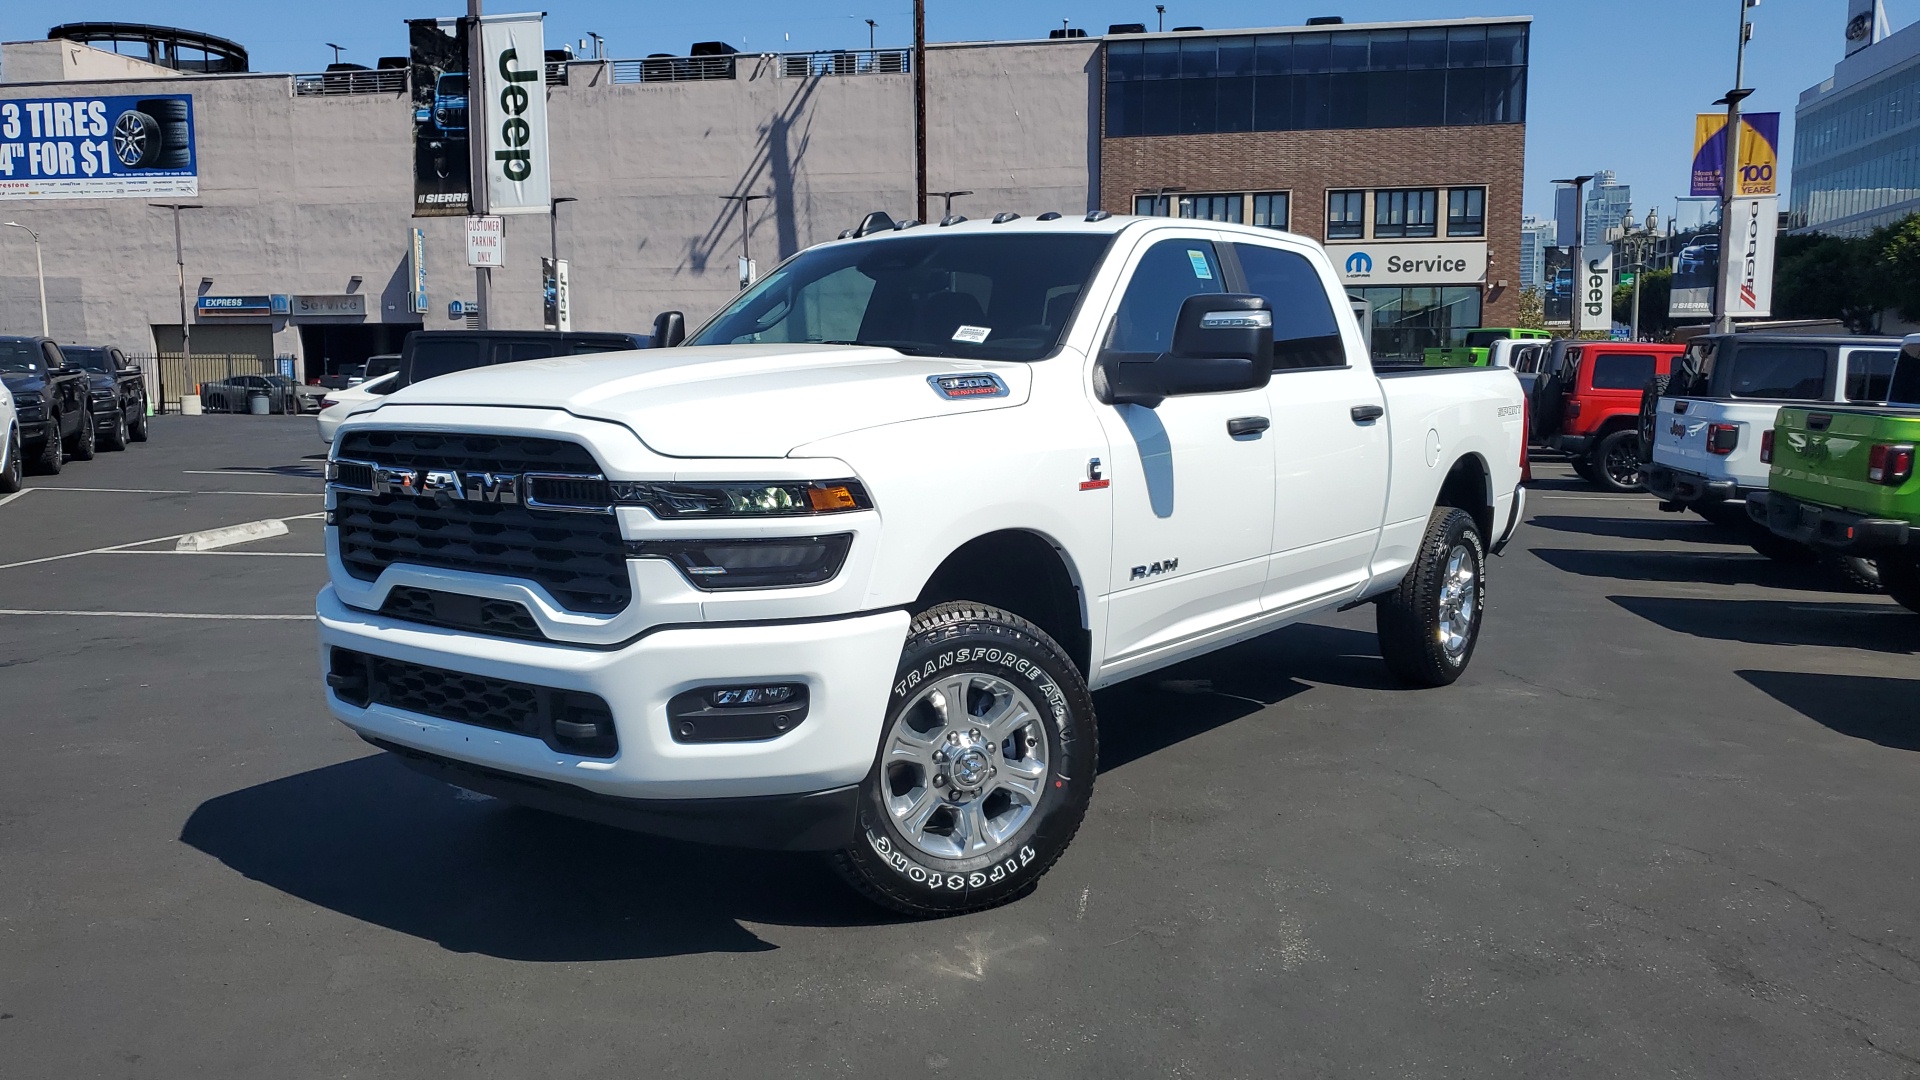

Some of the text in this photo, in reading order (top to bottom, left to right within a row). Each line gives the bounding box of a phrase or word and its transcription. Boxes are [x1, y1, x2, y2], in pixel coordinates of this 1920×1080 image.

[2, 101, 108, 139] 3 TIRES
[495, 48, 538, 181] Jeep
[0, 138, 111, 177] 4TH FOR $1
[1739, 164, 1773, 182] 100
[425, 193, 469, 203] SIERRA
[1741, 186, 1771, 194] YEARS
[468, 220, 500, 232] CUSTOMER
[472, 236, 497, 247] PARKING
[1746, 201, 1759, 293] DODGE
[477, 251, 492, 262] ONLY
[1387, 255, 1467, 273] Service
[1585, 259, 1608, 317] Jeep
[205, 298, 243, 307] EXPRESS
[301, 299, 357, 311] Service
[559, 272, 568, 323] Jeep
[941, 378, 993, 390] 3500
[948, 387, 997, 397] HEAVY DUTY
[377, 466, 521, 504] RAM
[1129, 557, 1179, 582] RAM
[894, 647, 1042, 697] TRANSFORCE
[875, 835, 1036, 890] Firestone
